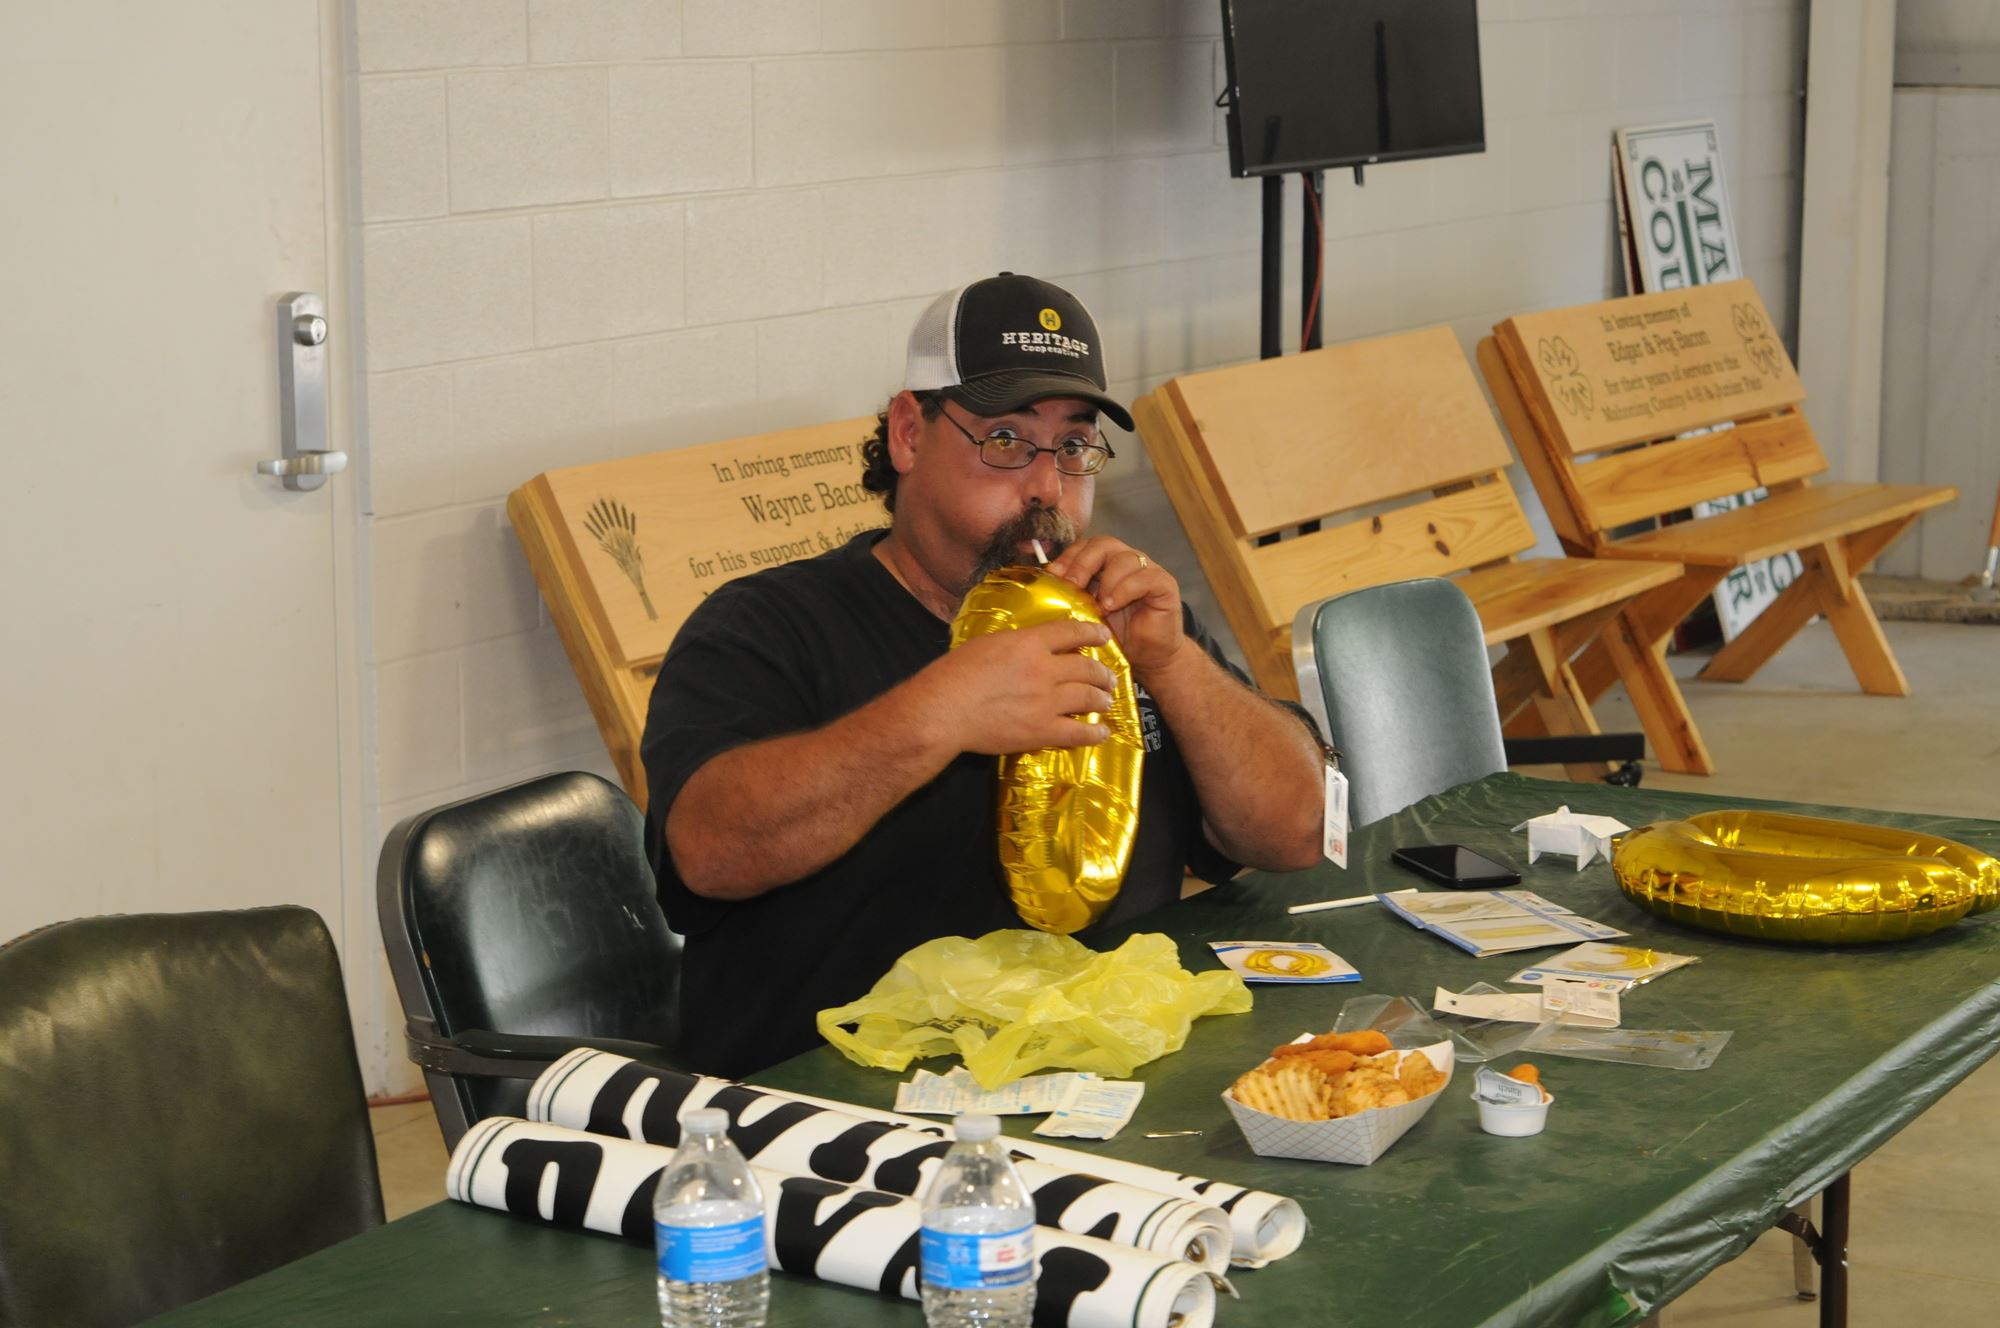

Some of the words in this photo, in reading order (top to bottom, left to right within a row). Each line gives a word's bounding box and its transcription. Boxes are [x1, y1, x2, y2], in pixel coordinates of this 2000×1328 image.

[1611, 313, 1646, 330] loving
[1643, 308, 1680, 324] memory
[1001, 332, 1090, 356] HERITAGE
[1021, 344, 1080, 359] Cooperative
[1606, 340, 1643, 364] Edgar
[1642, 335, 1656, 356] &
[1653, 333, 1679, 357] Peg
[1644, 371, 1672, 391] years
[1723, 353, 1741, 371] the
[711, 463, 735, 483] In
[734, 455, 791, 479] loving
[789, 445, 854, 469] memory
[741, 492, 816, 527] Wayne
[814, 481, 876, 510] Baco
[689, 556, 715, 579] for
[716, 550, 747, 573] his
[750, 536, 817, 567] support
[816, 531, 834, 553] &
